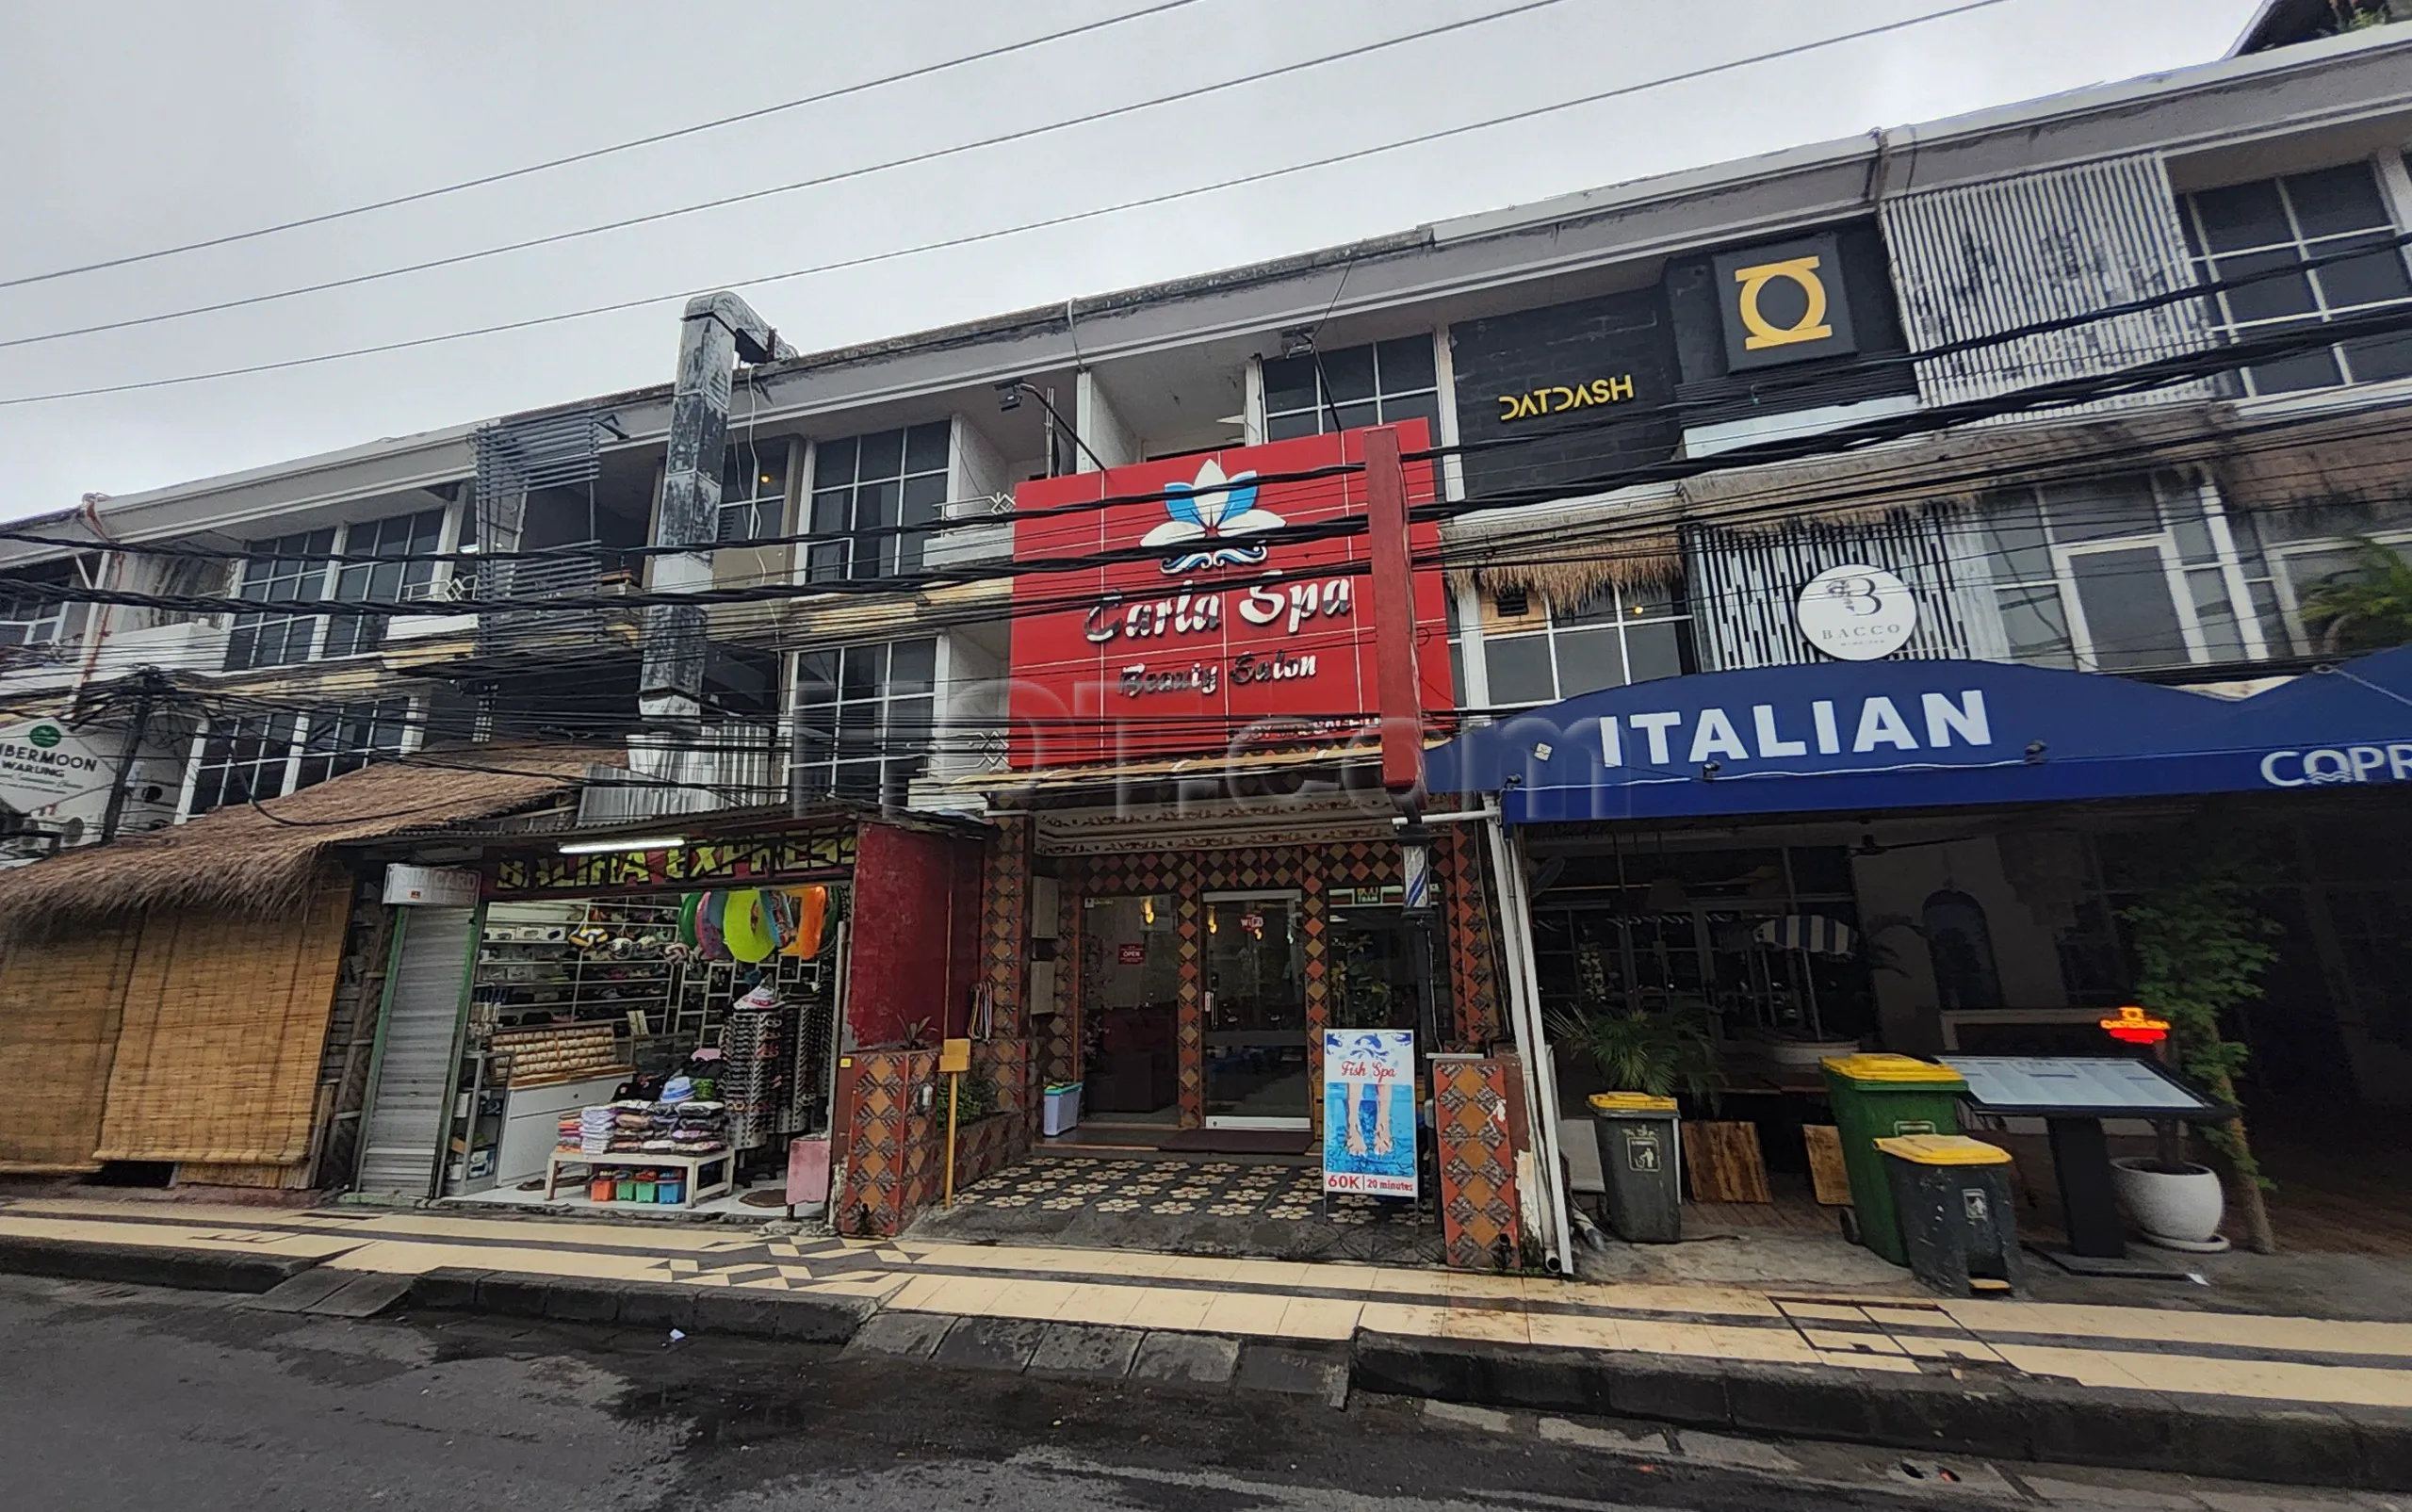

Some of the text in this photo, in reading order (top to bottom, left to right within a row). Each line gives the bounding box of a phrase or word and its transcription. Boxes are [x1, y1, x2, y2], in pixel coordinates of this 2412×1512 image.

[1498, 374, 1635, 421] DATDASH
[1238, 569, 1350, 635] Spa
[1822, 623, 1901, 641] BACCO
[1230, 649, 1317, 685] Salon
[1599, 689, 1993, 769] ITALIAN
[433, 870, 478, 891] CARD
[1122, 950, 1141, 958] OPEN
[1341, 1060, 1396, 1082] Fish Spa
[1328, 1175, 1413, 1192] 60K 20 minutes
